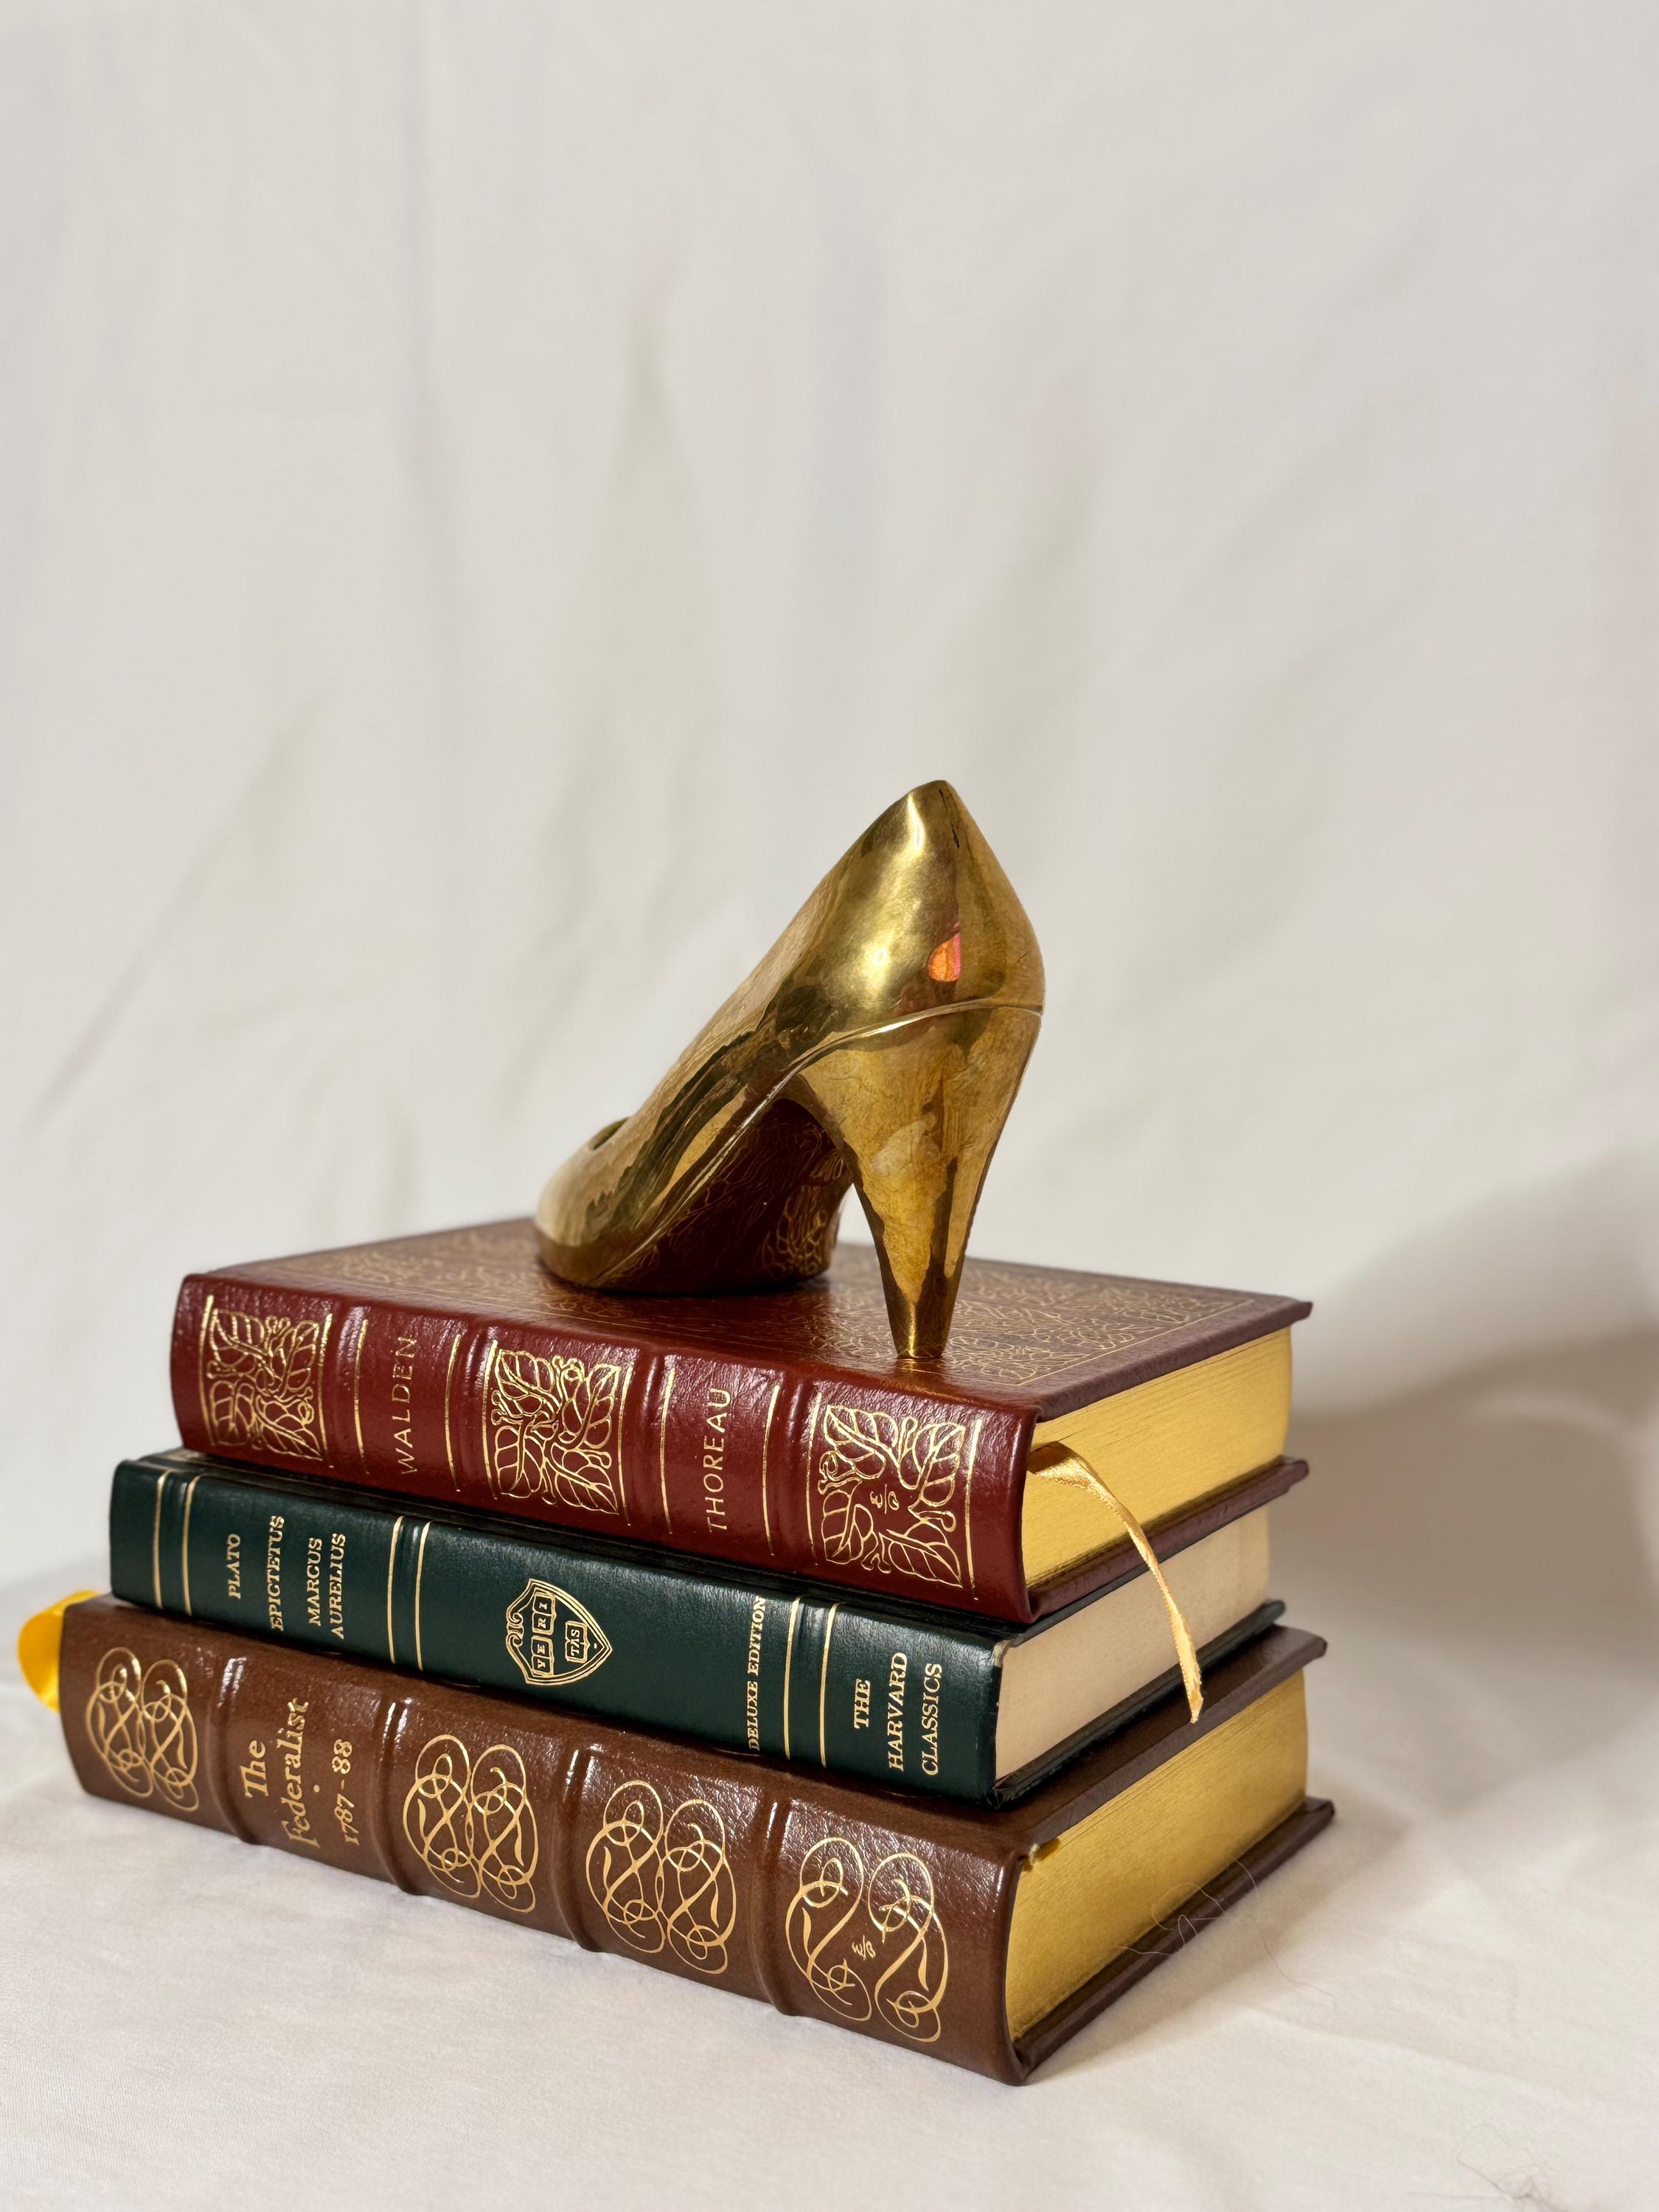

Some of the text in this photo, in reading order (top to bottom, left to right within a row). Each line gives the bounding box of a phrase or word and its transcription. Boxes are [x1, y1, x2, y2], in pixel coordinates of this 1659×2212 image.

[392, 1337, 417, 1474] WALDEN
[703, 1388, 731, 1533] THOREAU
[226, 1533, 241, 1599] PLATO
[266, 1515, 285, 1632] EPICTETUS
[307, 1537, 323, 1627] MARCUS
[329, 1533, 347, 1640] AURELIUS
[747, 1595, 766, 1751] DELUXE EDITION
[853, 1678, 871, 1729] THE
[887, 1652, 908, 1773] HARVARD
[922, 1663, 942, 1776] CLASSICS
[239, 1740, 269, 1798] The
[276, 1697, 321, 1848] Federalist
